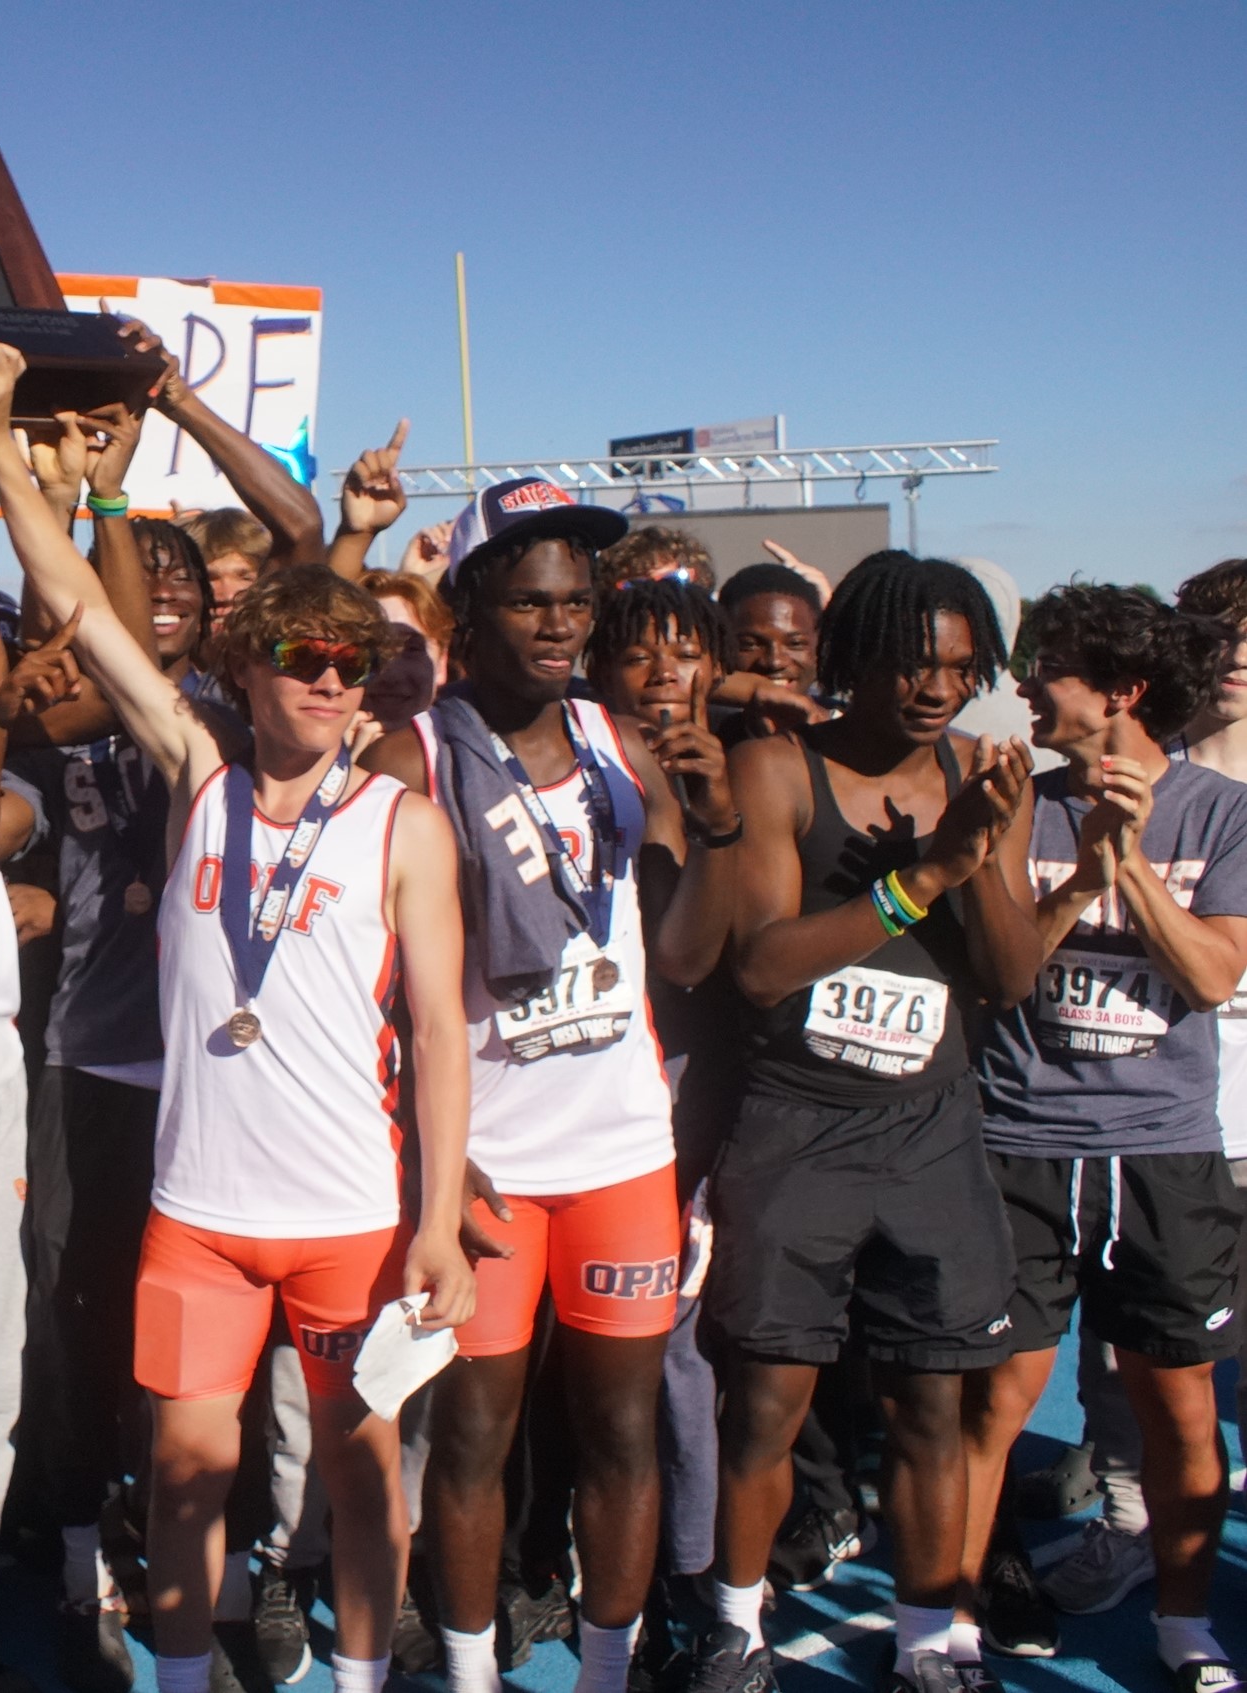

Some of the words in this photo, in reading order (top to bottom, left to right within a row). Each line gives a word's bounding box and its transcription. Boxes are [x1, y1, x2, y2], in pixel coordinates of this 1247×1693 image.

[1046, 963, 1151, 1013] 3974
[823, 981, 925, 1034] 3976
[1058, 1006, 1092, 1021] CLASS
[1095, 1009, 1110, 1023] 3A
[1114, 1012, 1143, 1026] BOYS
[837, 1022, 874, 1037] CLASS
[889, 1032, 914, 1045] BOYS
[1070, 1030, 1098, 1052] IHSA
[1097, 1033, 1136, 1054] TRACK
